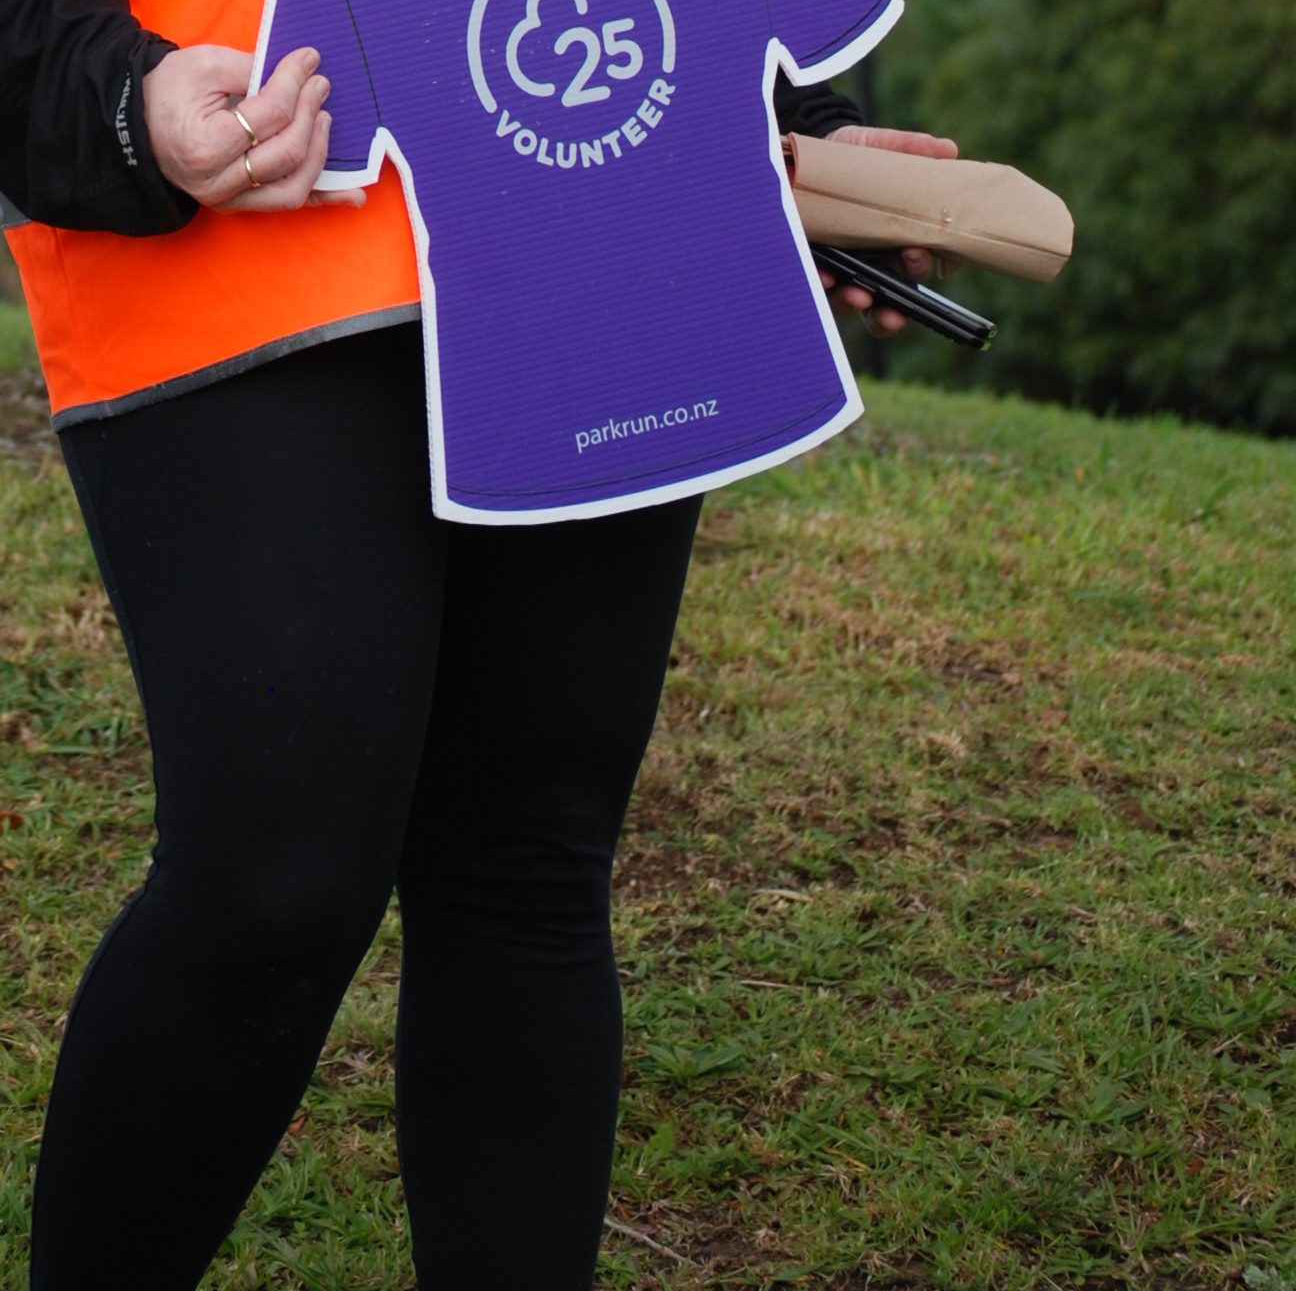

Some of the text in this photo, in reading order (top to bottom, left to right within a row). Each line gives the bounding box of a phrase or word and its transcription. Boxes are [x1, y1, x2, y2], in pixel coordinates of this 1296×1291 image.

[554, 18, 644, 107] 25
[495, 78, 676, 169] VOLUNTEER
[575, 398, 719, 454] parkrun.co.nz
